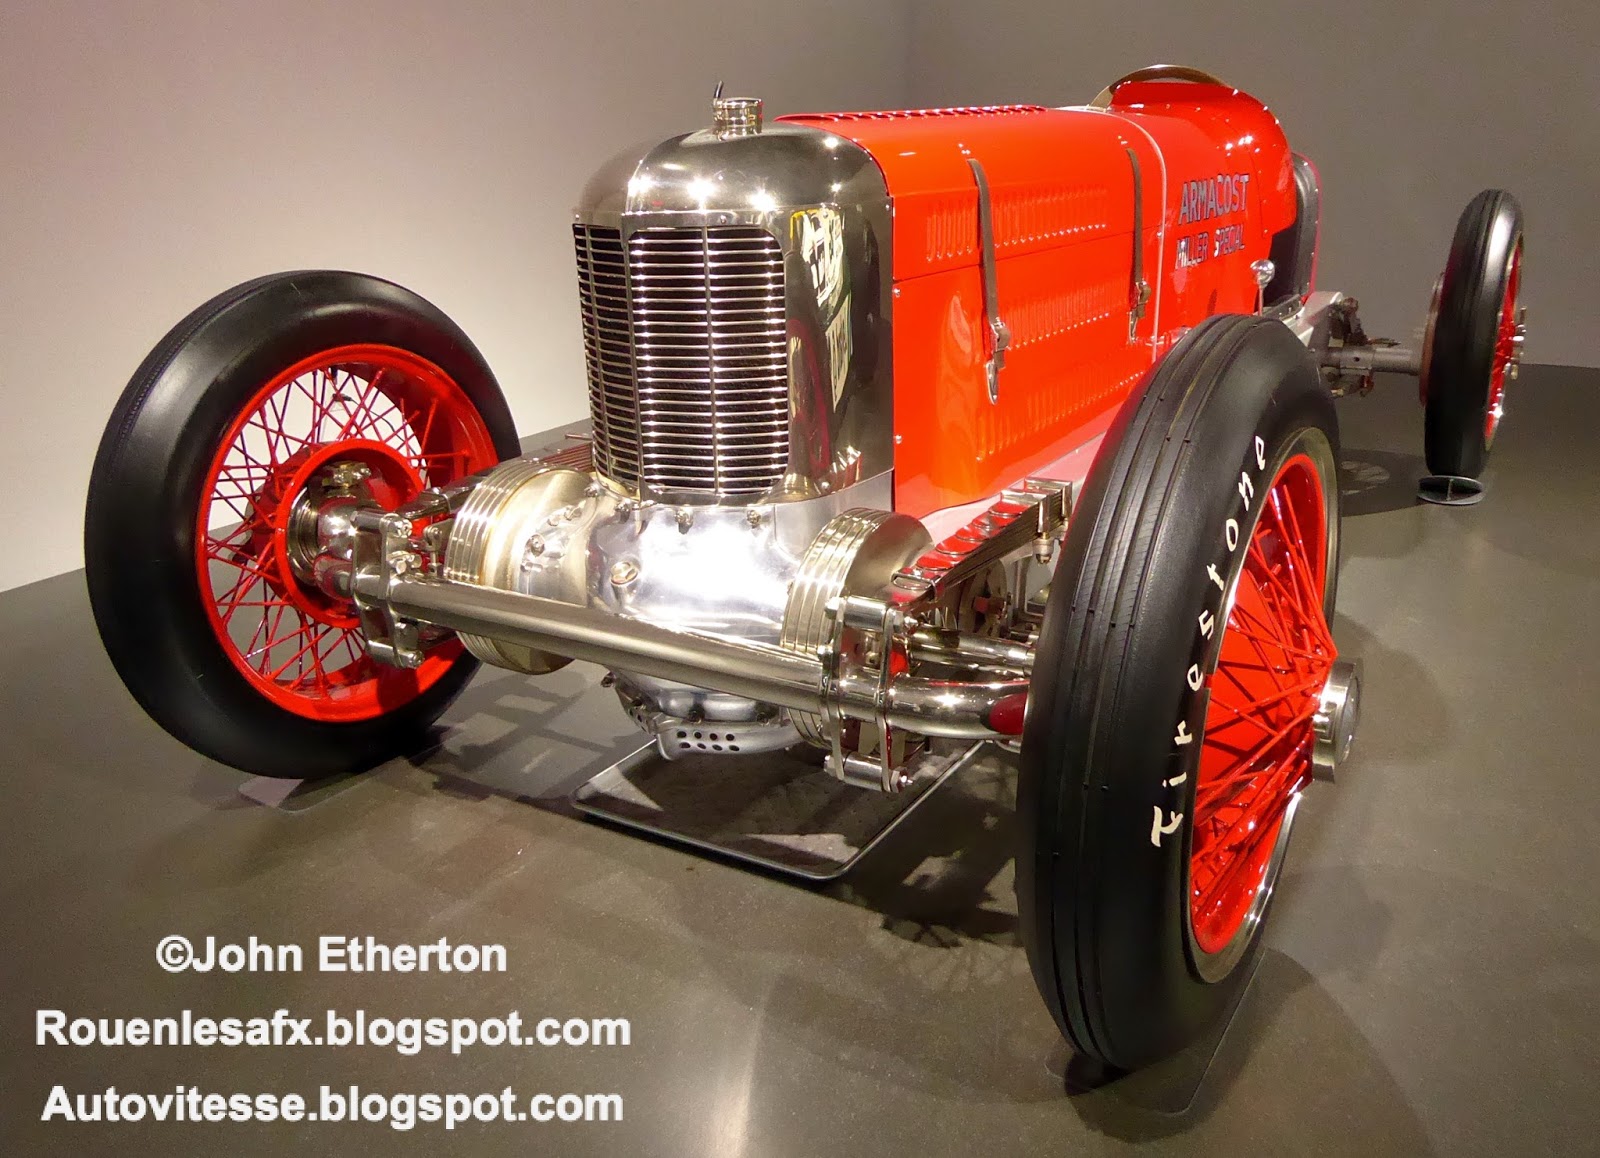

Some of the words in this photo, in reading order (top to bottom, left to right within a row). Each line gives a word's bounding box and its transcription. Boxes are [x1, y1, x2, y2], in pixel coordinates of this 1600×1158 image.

[1178, 173, 1249, 225] ARMACOST
[1213, 222, 1245, 257] SPECIAL
[1150, 435, 1265, 848] Firestone
